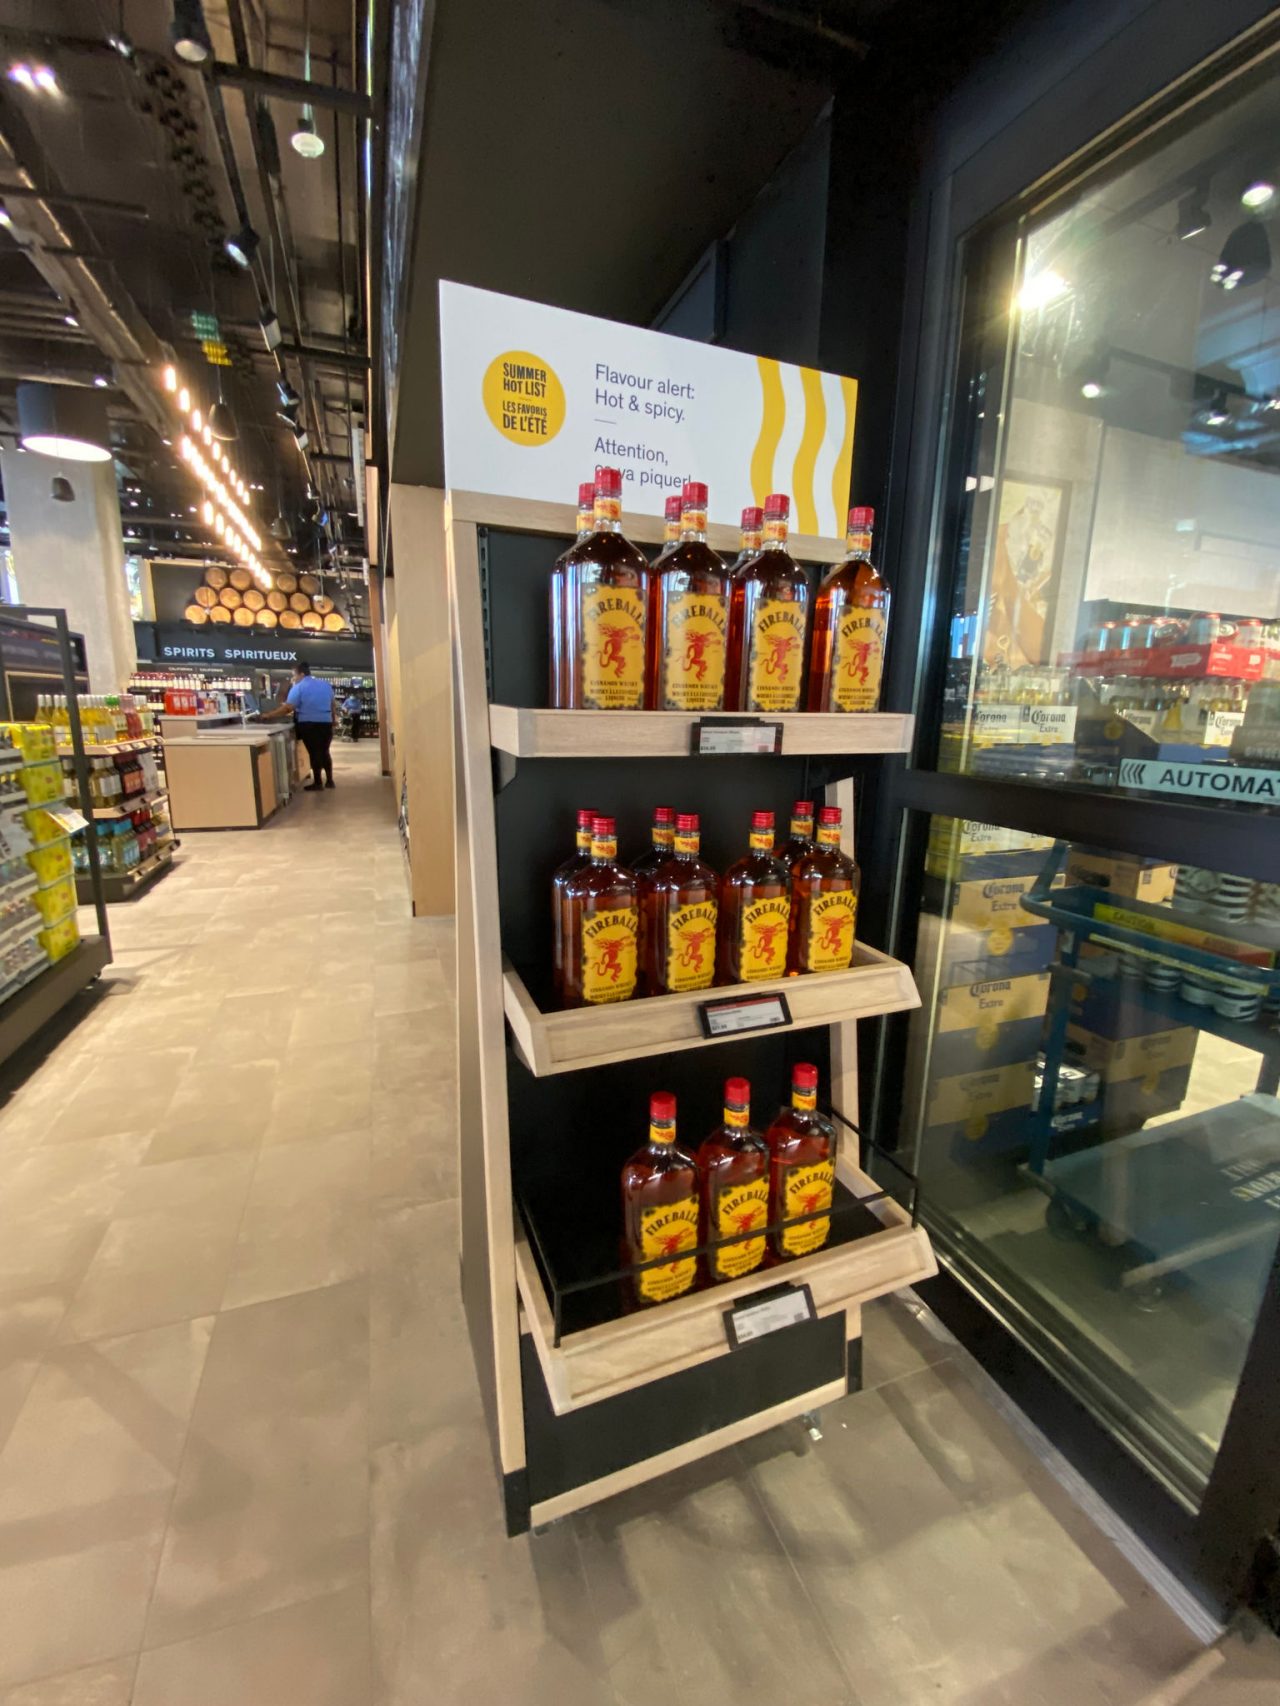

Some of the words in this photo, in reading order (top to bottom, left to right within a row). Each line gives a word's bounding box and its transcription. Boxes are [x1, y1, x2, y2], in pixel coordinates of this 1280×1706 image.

[503, 362, 546, 382] SUMMER
[595, 363, 653, 390] Flavour
[657, 378, 695, 400] alert:
[503, 378, 523, 394] HOT
[525, 380, 546, 398] LIST
[502, 400, 516, 413] LES
[517, 403, 547, 417] FAVORIS
[595, 388, 624, 409] Hot
[628, 395, 640, 412] &
[645, 401, 685, 424] spicy.
[503, 413, 517, 430] DE
[594, 437, 669, 466] Attention,
[164, 646, 215, 658] SPIRITS
[224, 649, 297, 661] SPIRITUEUX
[1031, 709, 1066, 724] Corona
[1159, 769, 1280, 796] AUTOMA
[983, 882, 1025, 898] Corona
[745, 903, 790, 924] FIREBALL
[813, 896, 857, 916] FIREBALL
[992, 901, 1017, 912] Extra
[585, 915, 637, 938] FIREBALL
[671, 908, 717, 931] FIREBALL
[970, 980, 1011, 997] Corona
[789, 1171, 833, 1194] FIREBALL
[722, 1190, 769, 1216] FIREBALL
[645, 1210, 698, 1236] FIREBALL
